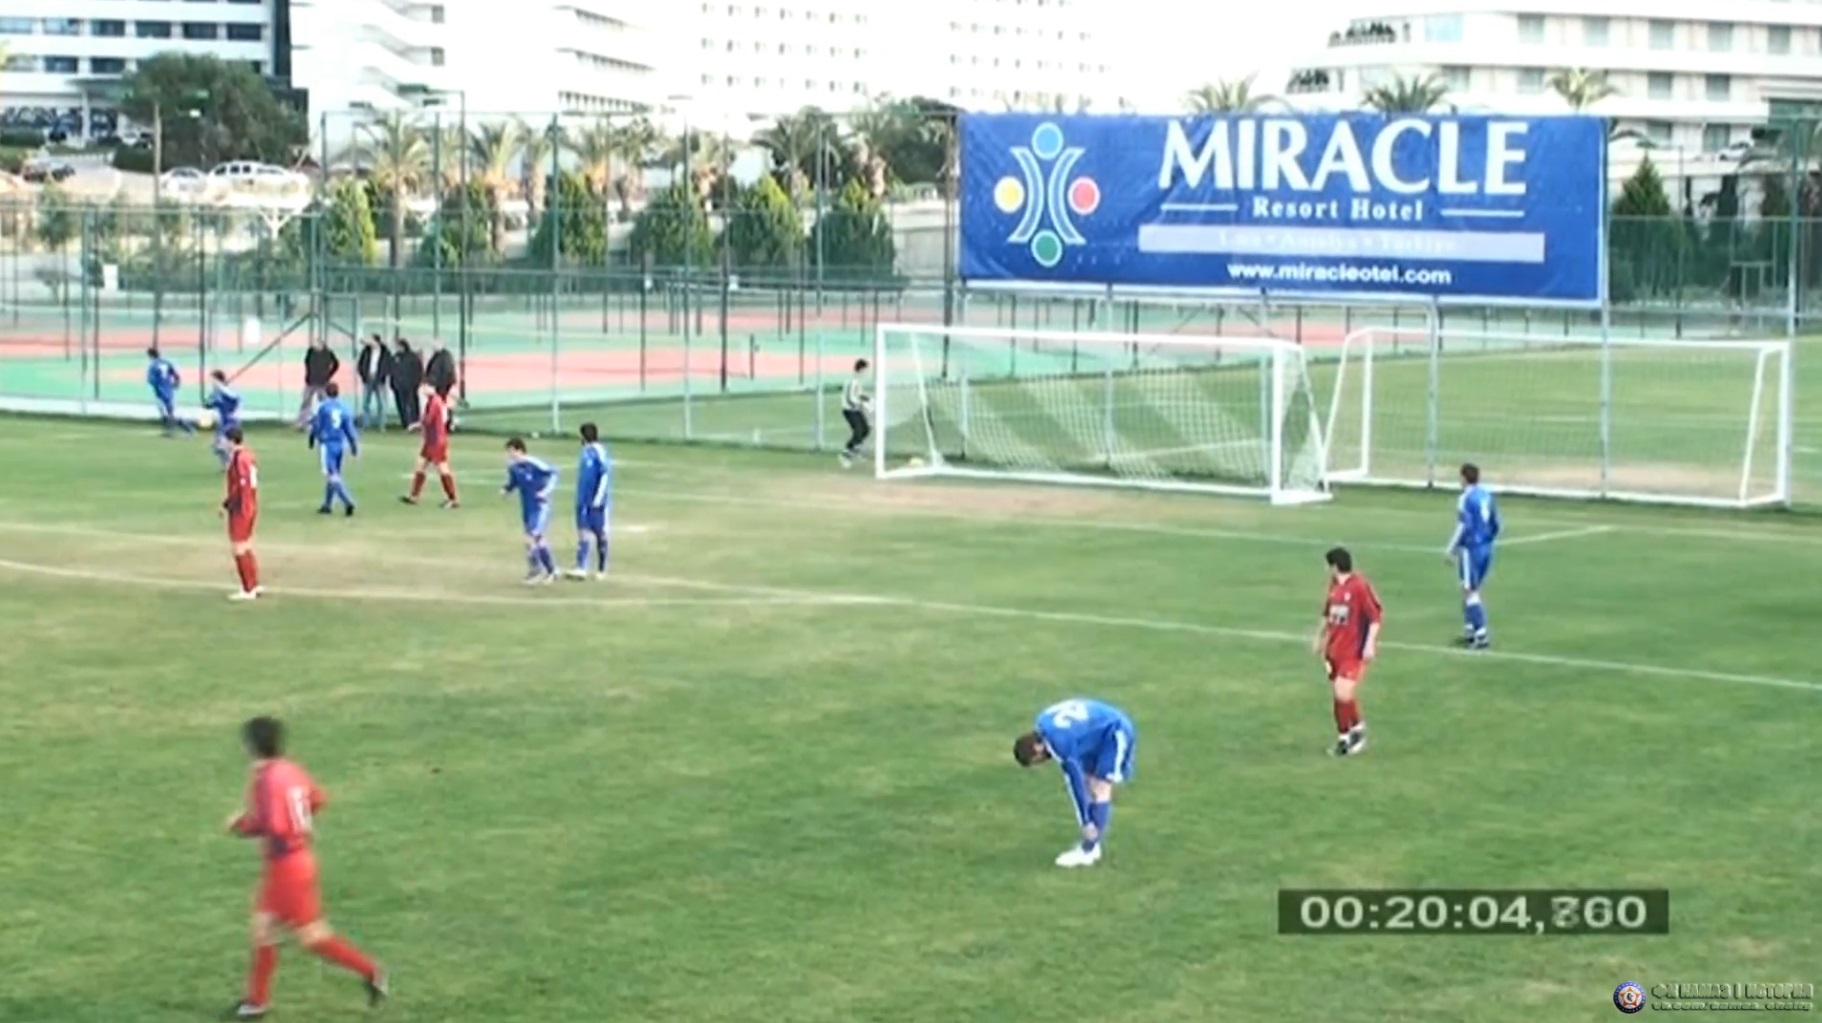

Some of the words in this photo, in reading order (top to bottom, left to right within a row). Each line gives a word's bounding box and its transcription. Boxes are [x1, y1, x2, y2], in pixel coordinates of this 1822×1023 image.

[1158, 118, 1528, 194] MIRACLE
[1252, 197, 1338, 219] Resort
[1350, 199, 1423, 221] Hotel
[1227, 262, 1452, 285] www.miracleotel.com
